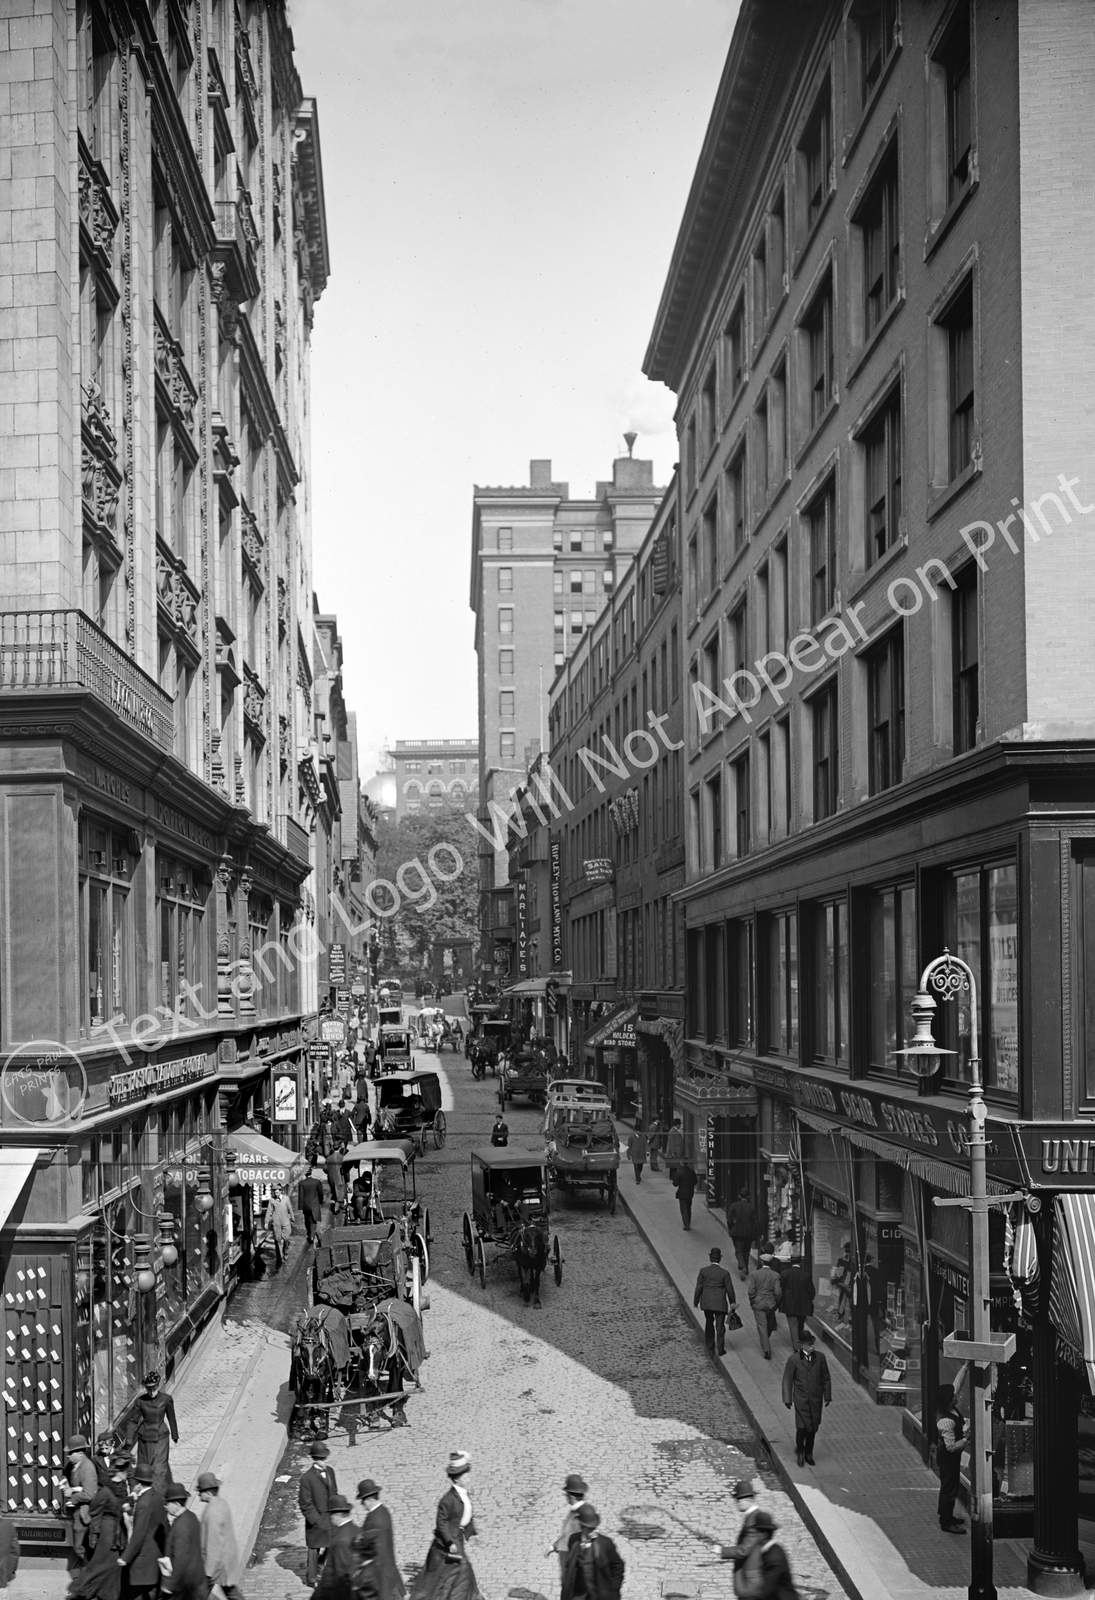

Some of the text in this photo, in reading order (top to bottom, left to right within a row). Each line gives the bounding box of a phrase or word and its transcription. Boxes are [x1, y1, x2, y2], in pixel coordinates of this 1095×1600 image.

[623, 1023, 634, 1032] 15
[840, 1091, 878, 1128] CIGAR
[881, 1103, 939, 1147] STORES
[234, 1152, 269, 1164] CIGARS
[236, 1168, 286, 1181] TOBACCO
[21, 1530, 52, 1538] TAILORING
